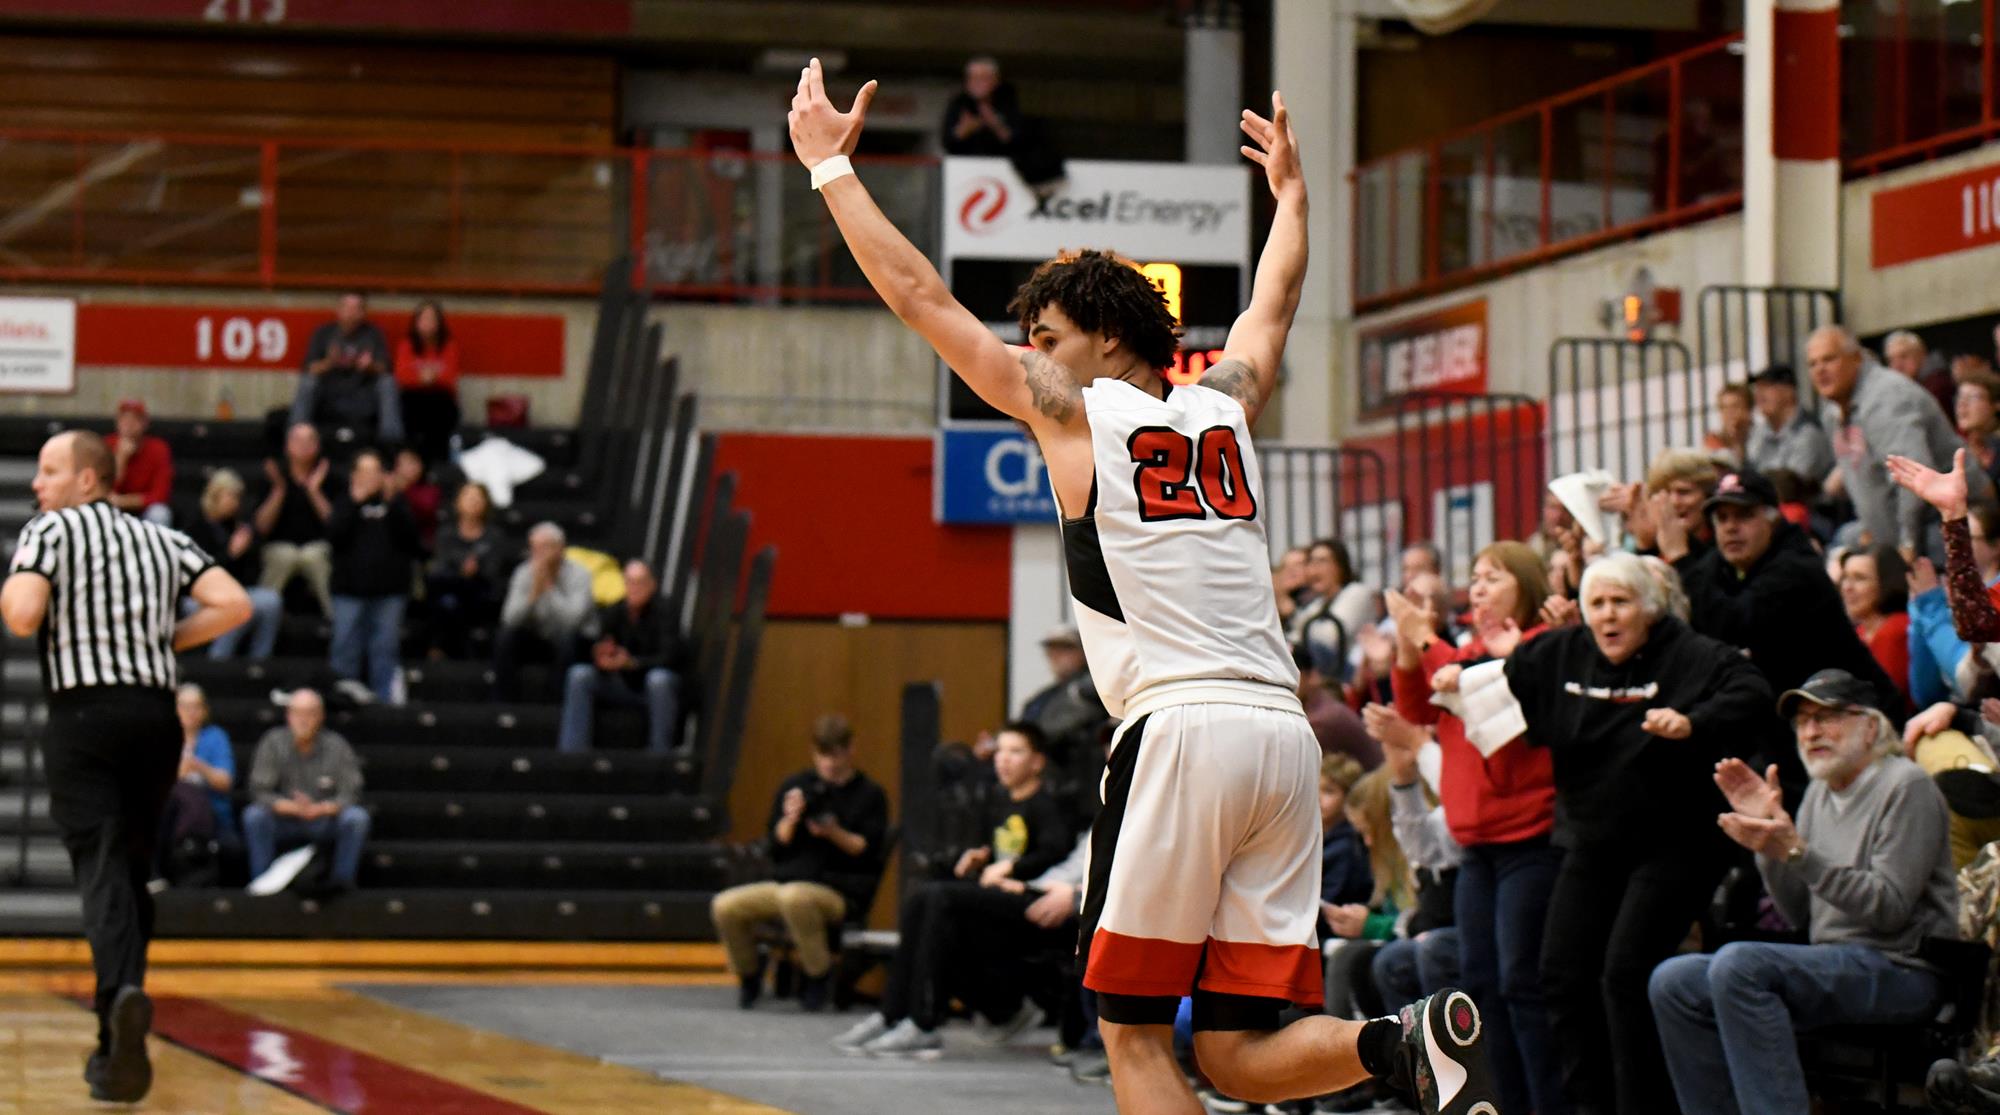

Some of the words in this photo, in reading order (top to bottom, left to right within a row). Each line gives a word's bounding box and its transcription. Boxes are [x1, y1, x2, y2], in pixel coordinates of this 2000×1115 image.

[1115, 190, 1227, 236] Energy
[195, 316, 288, 361] 109
[1127, 424, 1257, 522] 20
